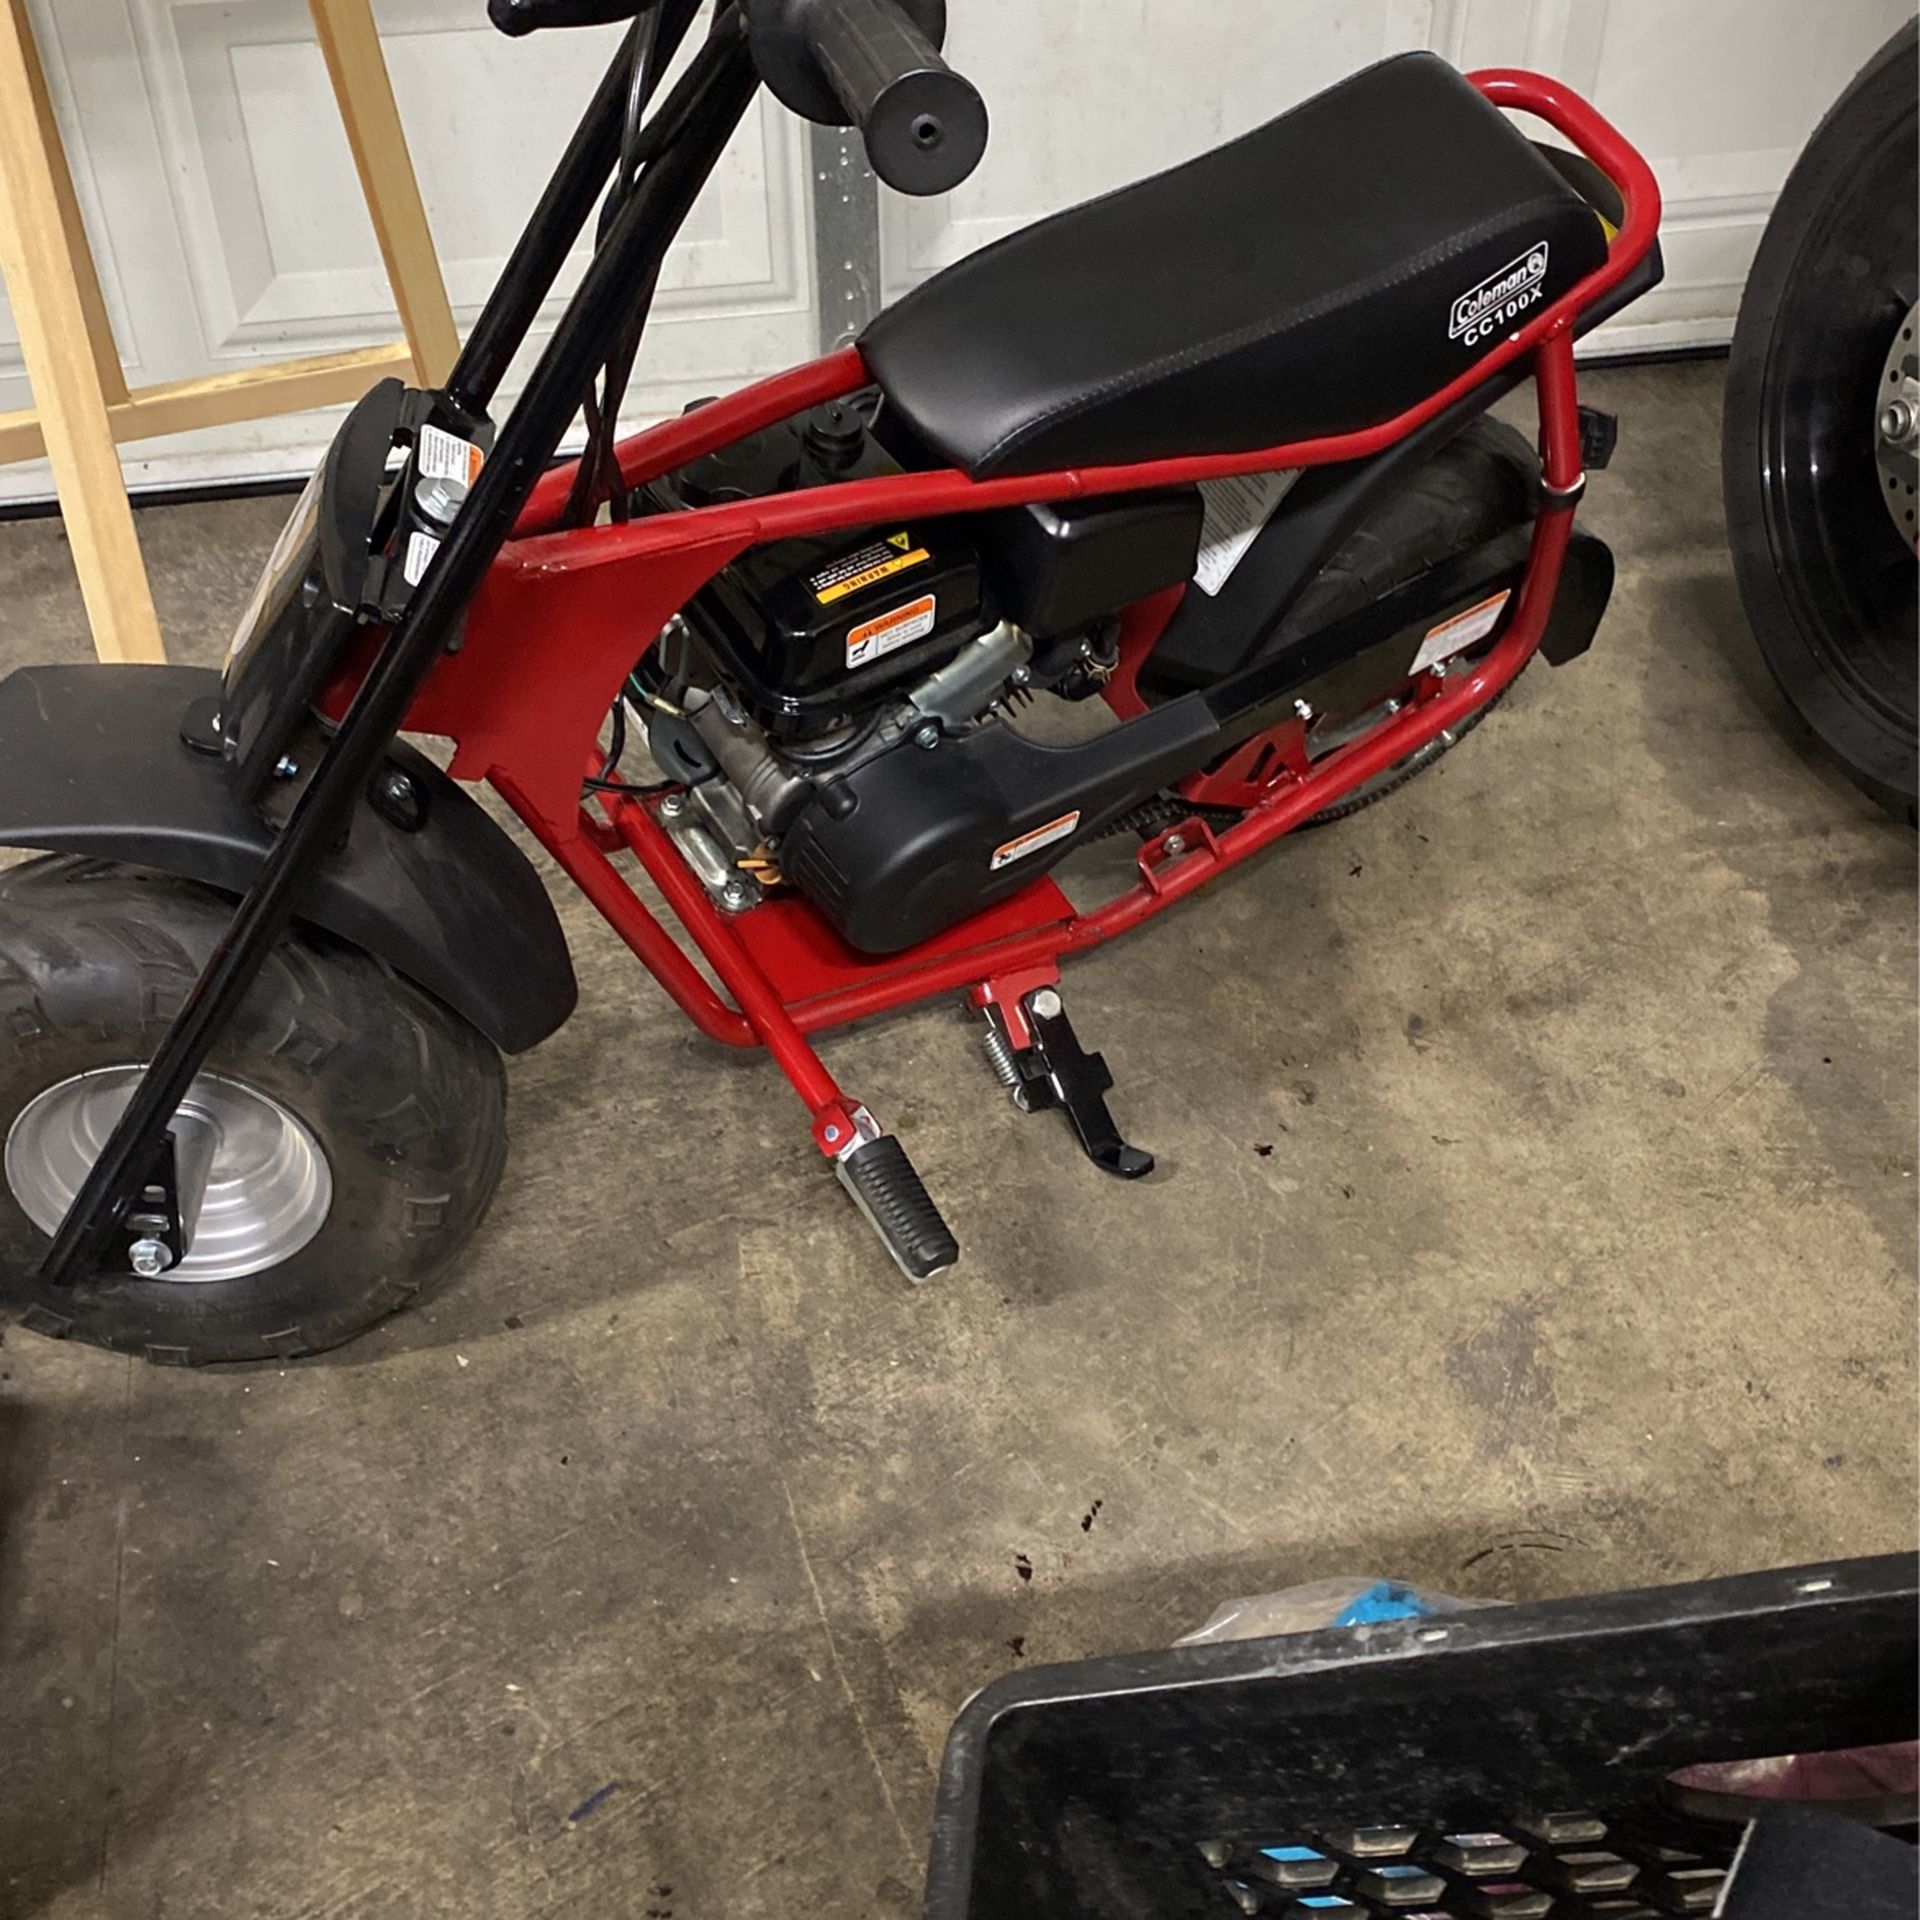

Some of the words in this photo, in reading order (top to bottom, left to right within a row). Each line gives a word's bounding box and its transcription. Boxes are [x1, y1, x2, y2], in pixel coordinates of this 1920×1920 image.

[1457, 266, 1527, 323] Coleman
[1464, 282, 1542, 346] CC100X
[843, 566, 889, 590] WARNING
